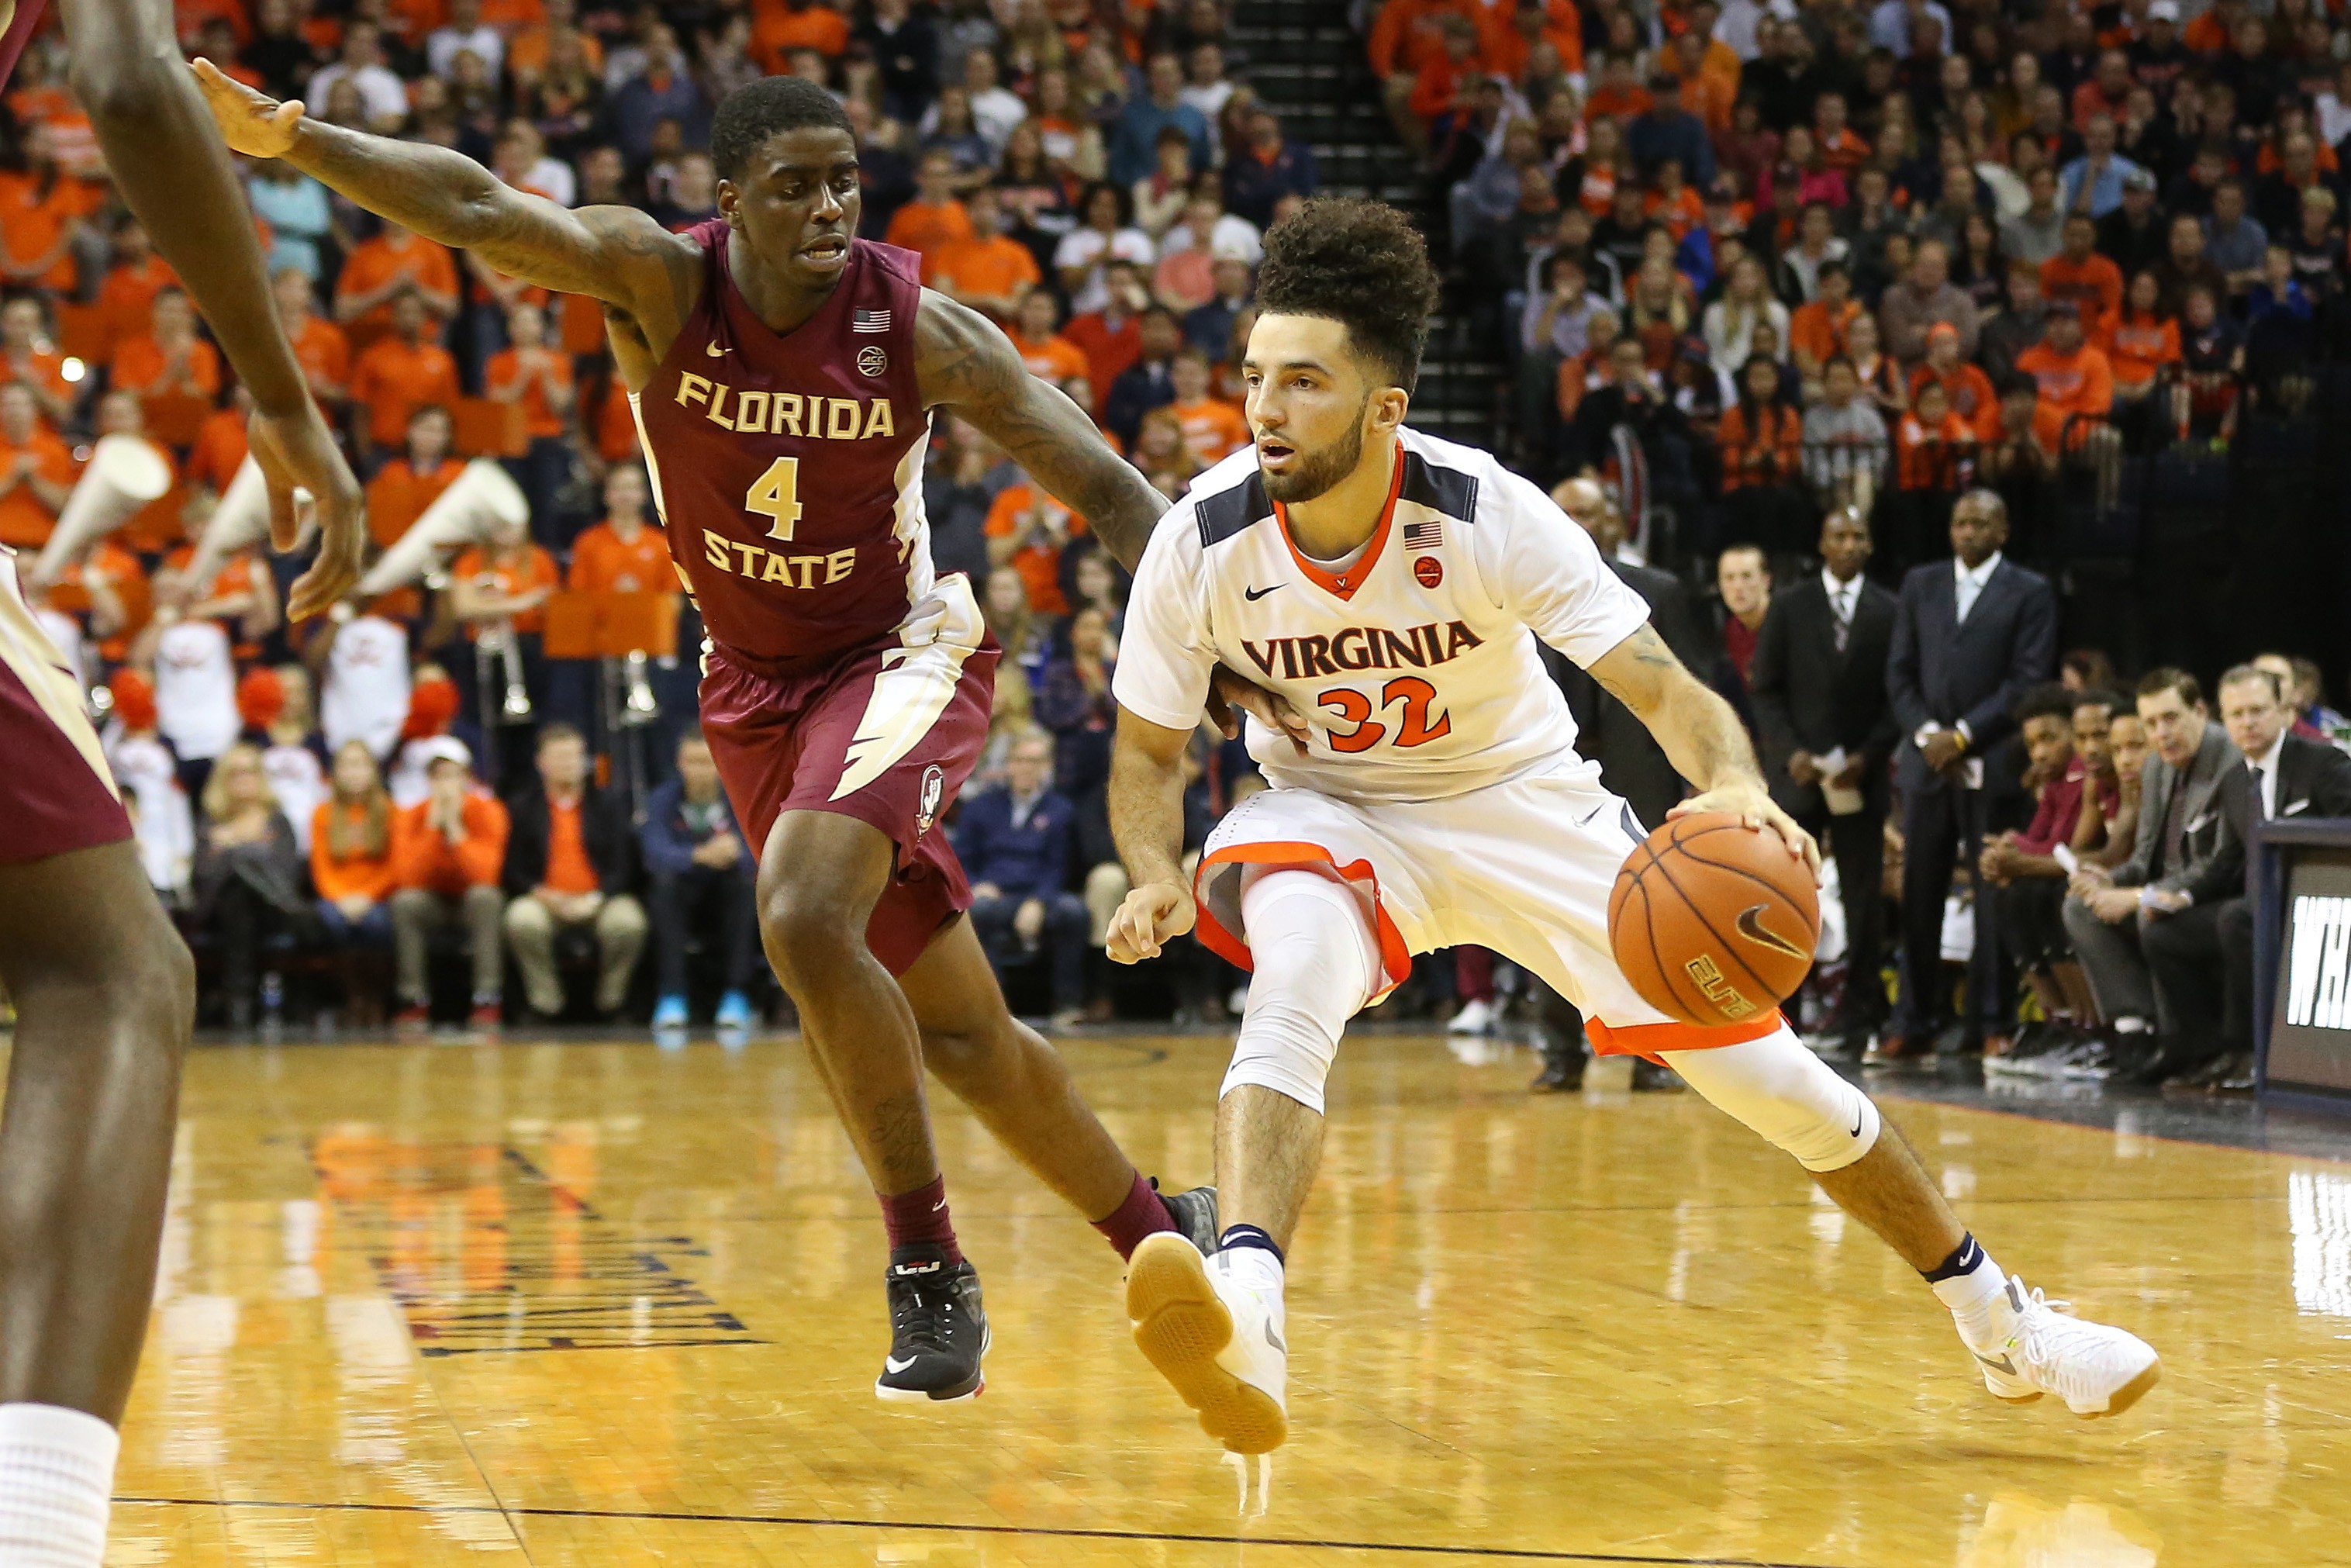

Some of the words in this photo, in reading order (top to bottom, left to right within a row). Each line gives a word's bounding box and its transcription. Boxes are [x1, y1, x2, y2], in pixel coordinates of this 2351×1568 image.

[674, 370, 895, 440] FLORIDA
[745, 456, 803, 542] 4
[703, 528, 856, 589] STATE
[1240, 620, 1486, 680] VIRGINIA
[1317, 675, 1452, 753] 32
